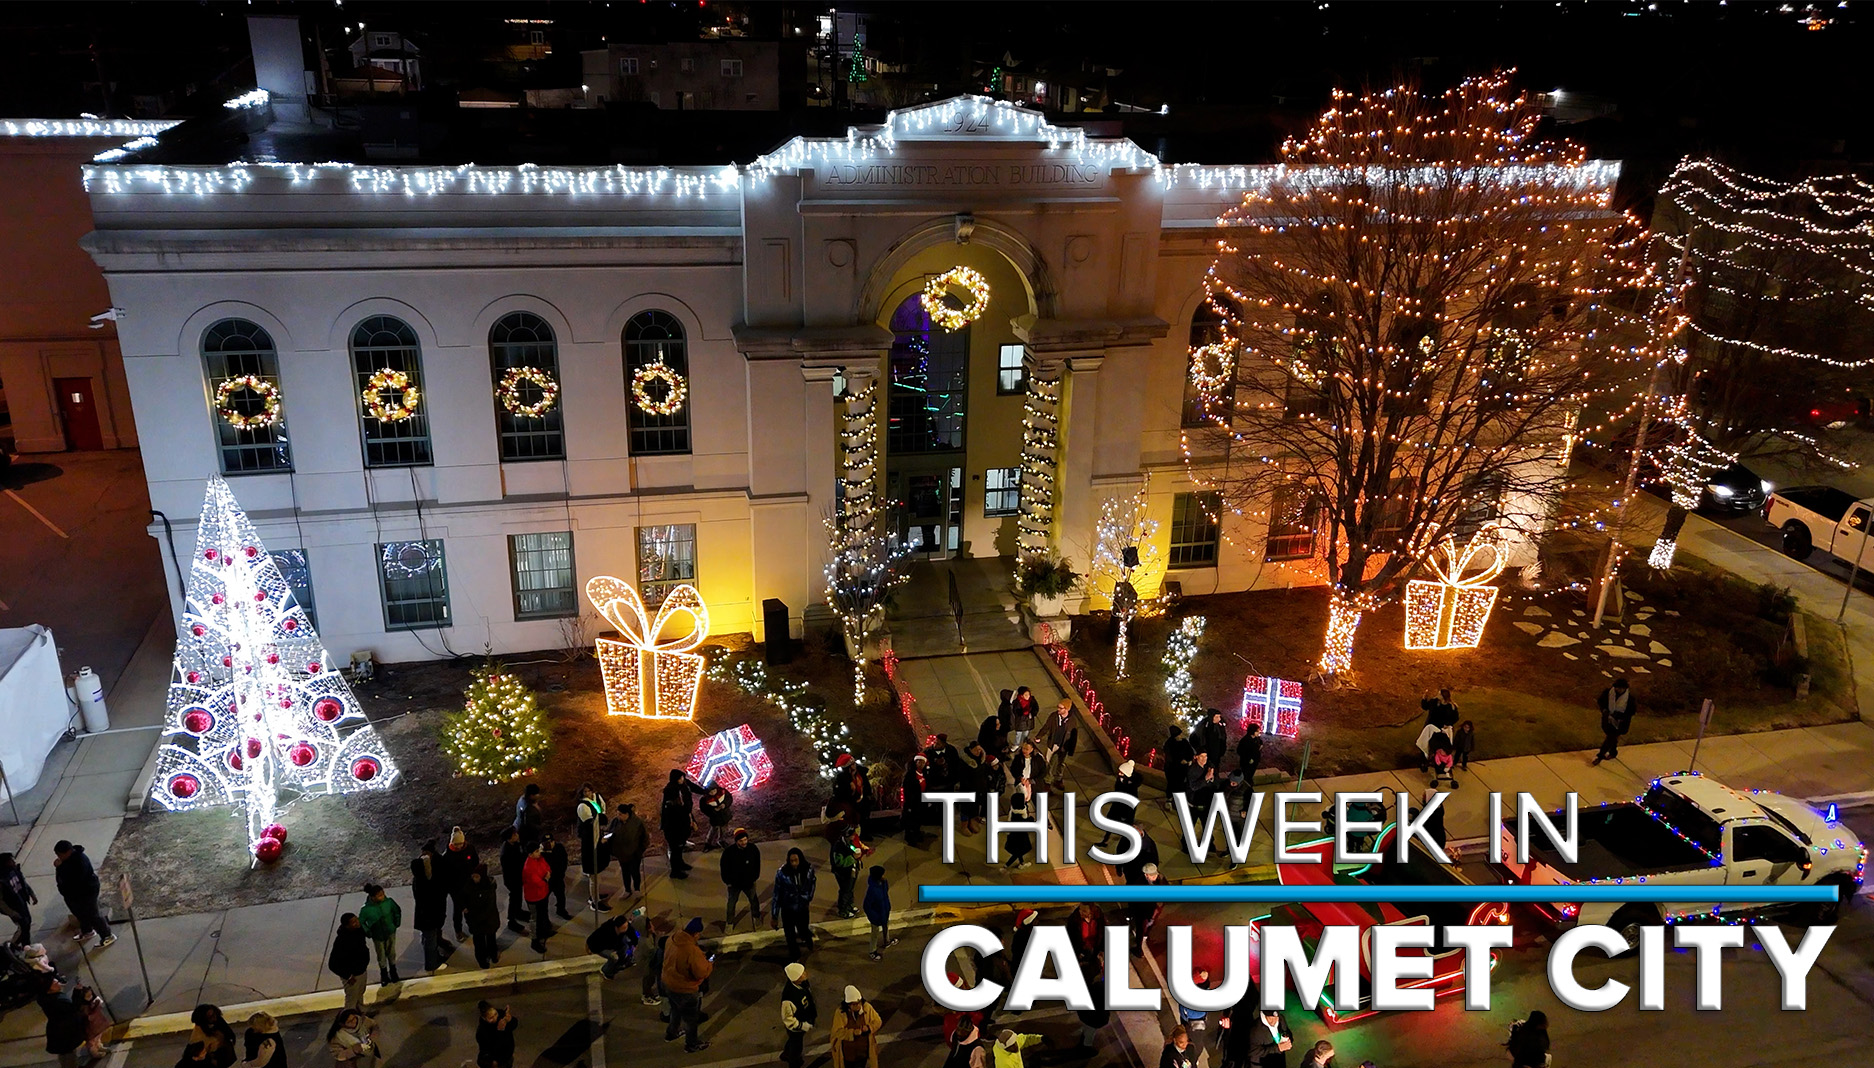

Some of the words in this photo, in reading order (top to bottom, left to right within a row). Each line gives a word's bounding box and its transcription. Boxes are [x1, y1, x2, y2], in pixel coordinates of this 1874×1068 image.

[943, 111, 989, 133] 1924
[825, 164, 1000, 186] ADMINISTRATION
[1010, 163, 1099, 185] BUILDING
